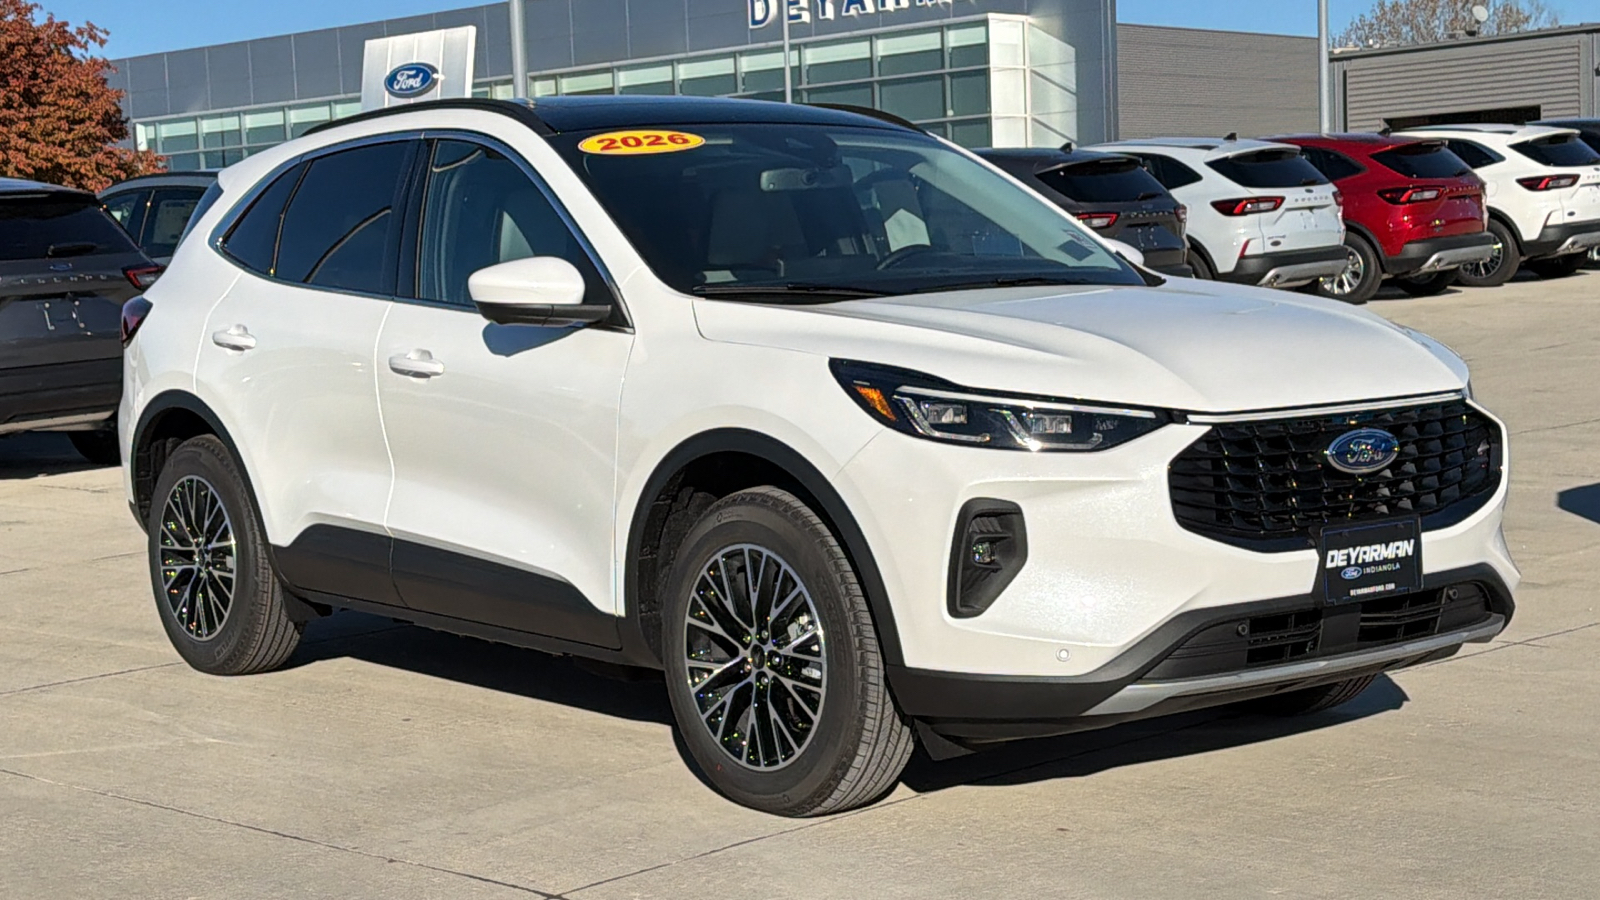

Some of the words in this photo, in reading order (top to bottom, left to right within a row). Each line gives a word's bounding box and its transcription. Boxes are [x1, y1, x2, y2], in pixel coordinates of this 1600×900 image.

[392, 69, 424, 90] Ford
[596, 134, 691, 151] 2026
[1346, 438, 1386, 464] Ford
[1326, 539, 1415, 568] DEYARMAN
[1363, 562, 1401, 575] INDIANOLA
